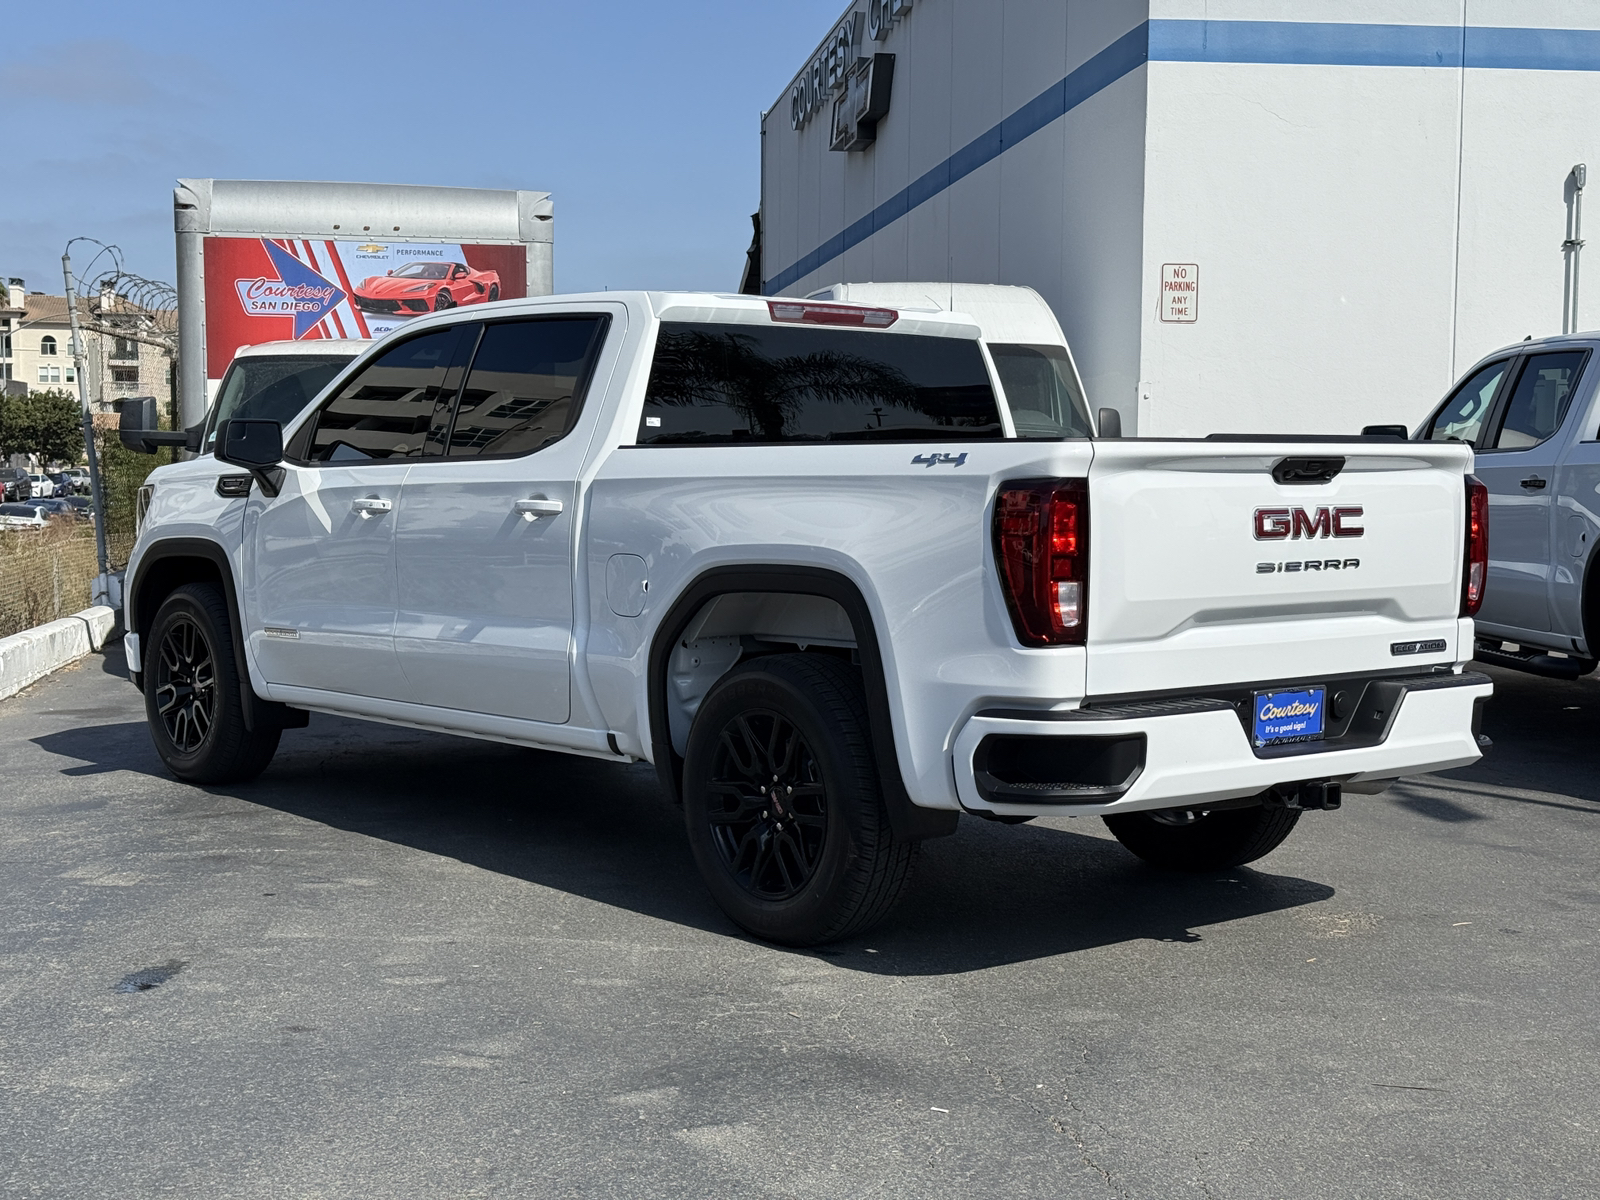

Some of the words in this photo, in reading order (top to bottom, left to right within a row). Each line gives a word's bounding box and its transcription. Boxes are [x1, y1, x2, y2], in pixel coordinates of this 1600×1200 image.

[790, 11, 858, 131] COURTESY
[396, 249, 444, 257] PERFORMANCE
[1173, 268, 1187, 279] NO
[246, 276, 335, 306] Courtesy
[1164, 281, 1196, 292] PARKING
[251, 301, 277, 310] SAN
[280, 301, 321, 312] DIEGO
[1171, 296, 1188, 305] ANY
[1170, 307, 1189, 316] TIME
[1253, 506, 1364, 541] GMC
[1255, 558, 1361, 574] SIERRA
[1260, 699, 1319, 721] Courtesy
[1265, 725, 1275, 734] It's
[1280, 722, 1293, 734] good
[1294, 720, 1306, 731] sign!
